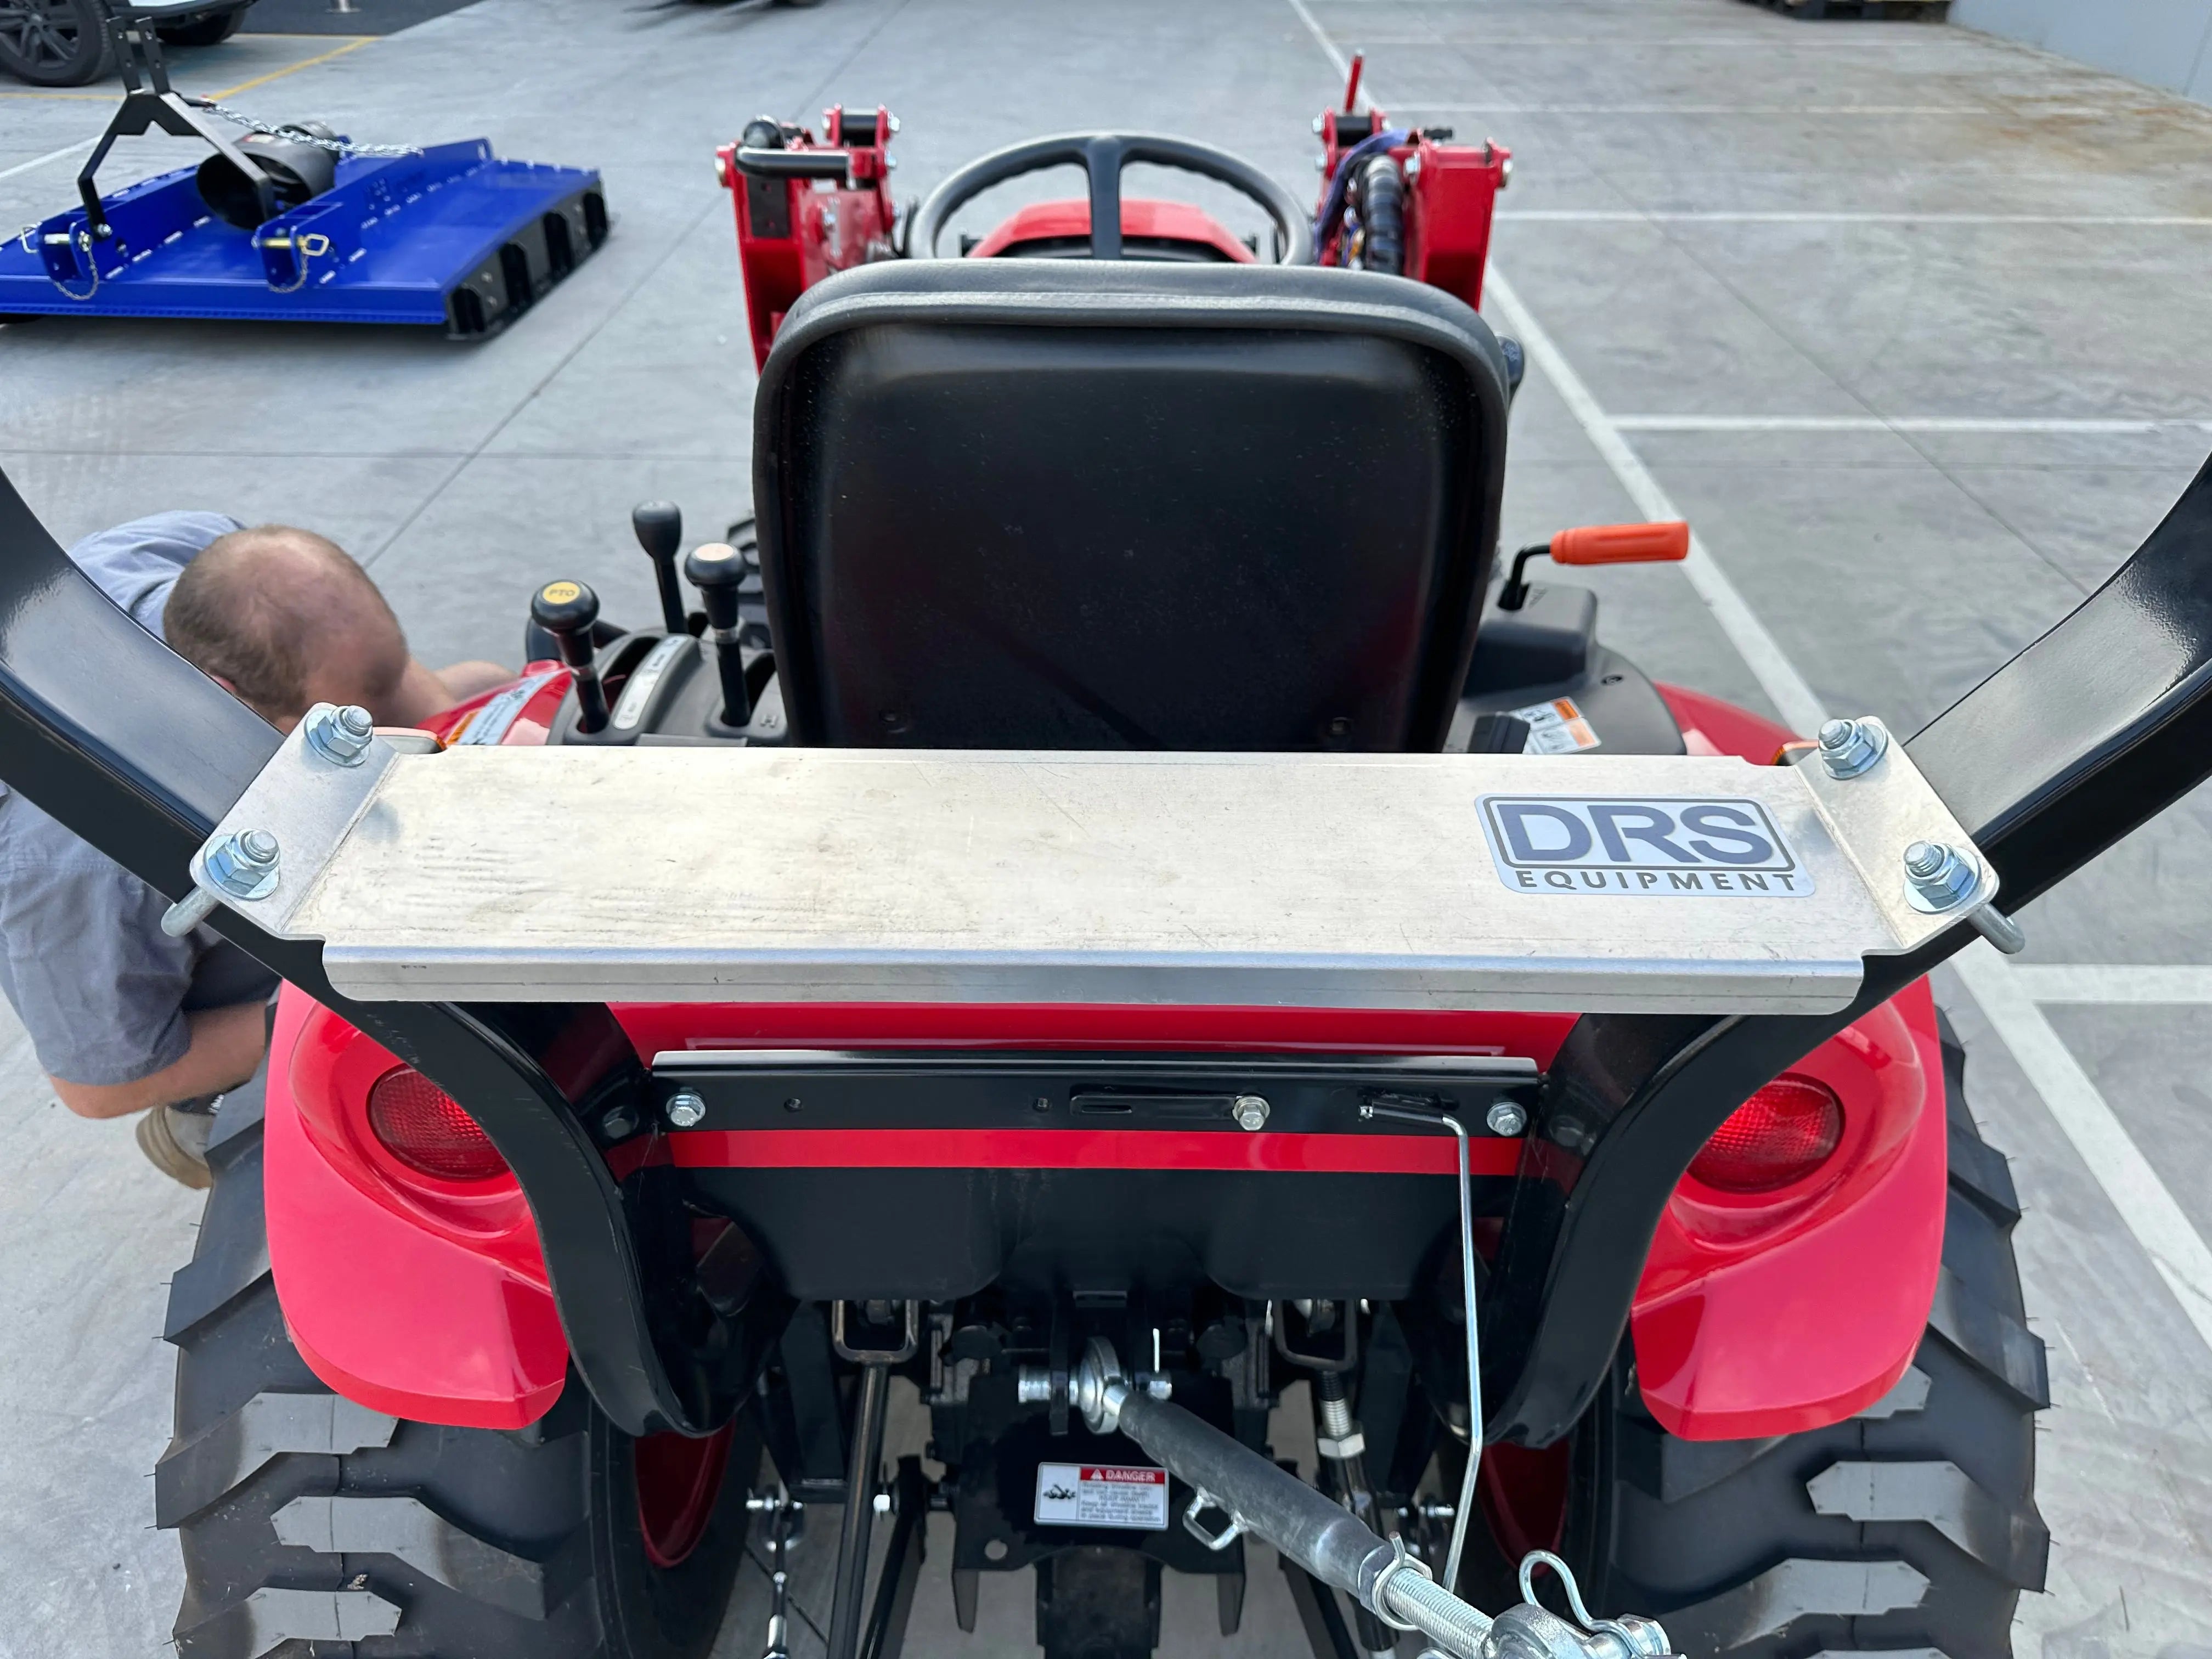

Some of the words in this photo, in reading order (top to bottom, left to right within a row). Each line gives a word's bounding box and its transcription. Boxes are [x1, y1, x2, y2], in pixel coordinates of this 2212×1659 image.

[549, 589, 575, 597] PTO
[1497, 804, 1773, 864] DRS
[1516, 870, 1795, 891] EQUIPMENT
[1105, 1470, 1156, 1482] DANGER
